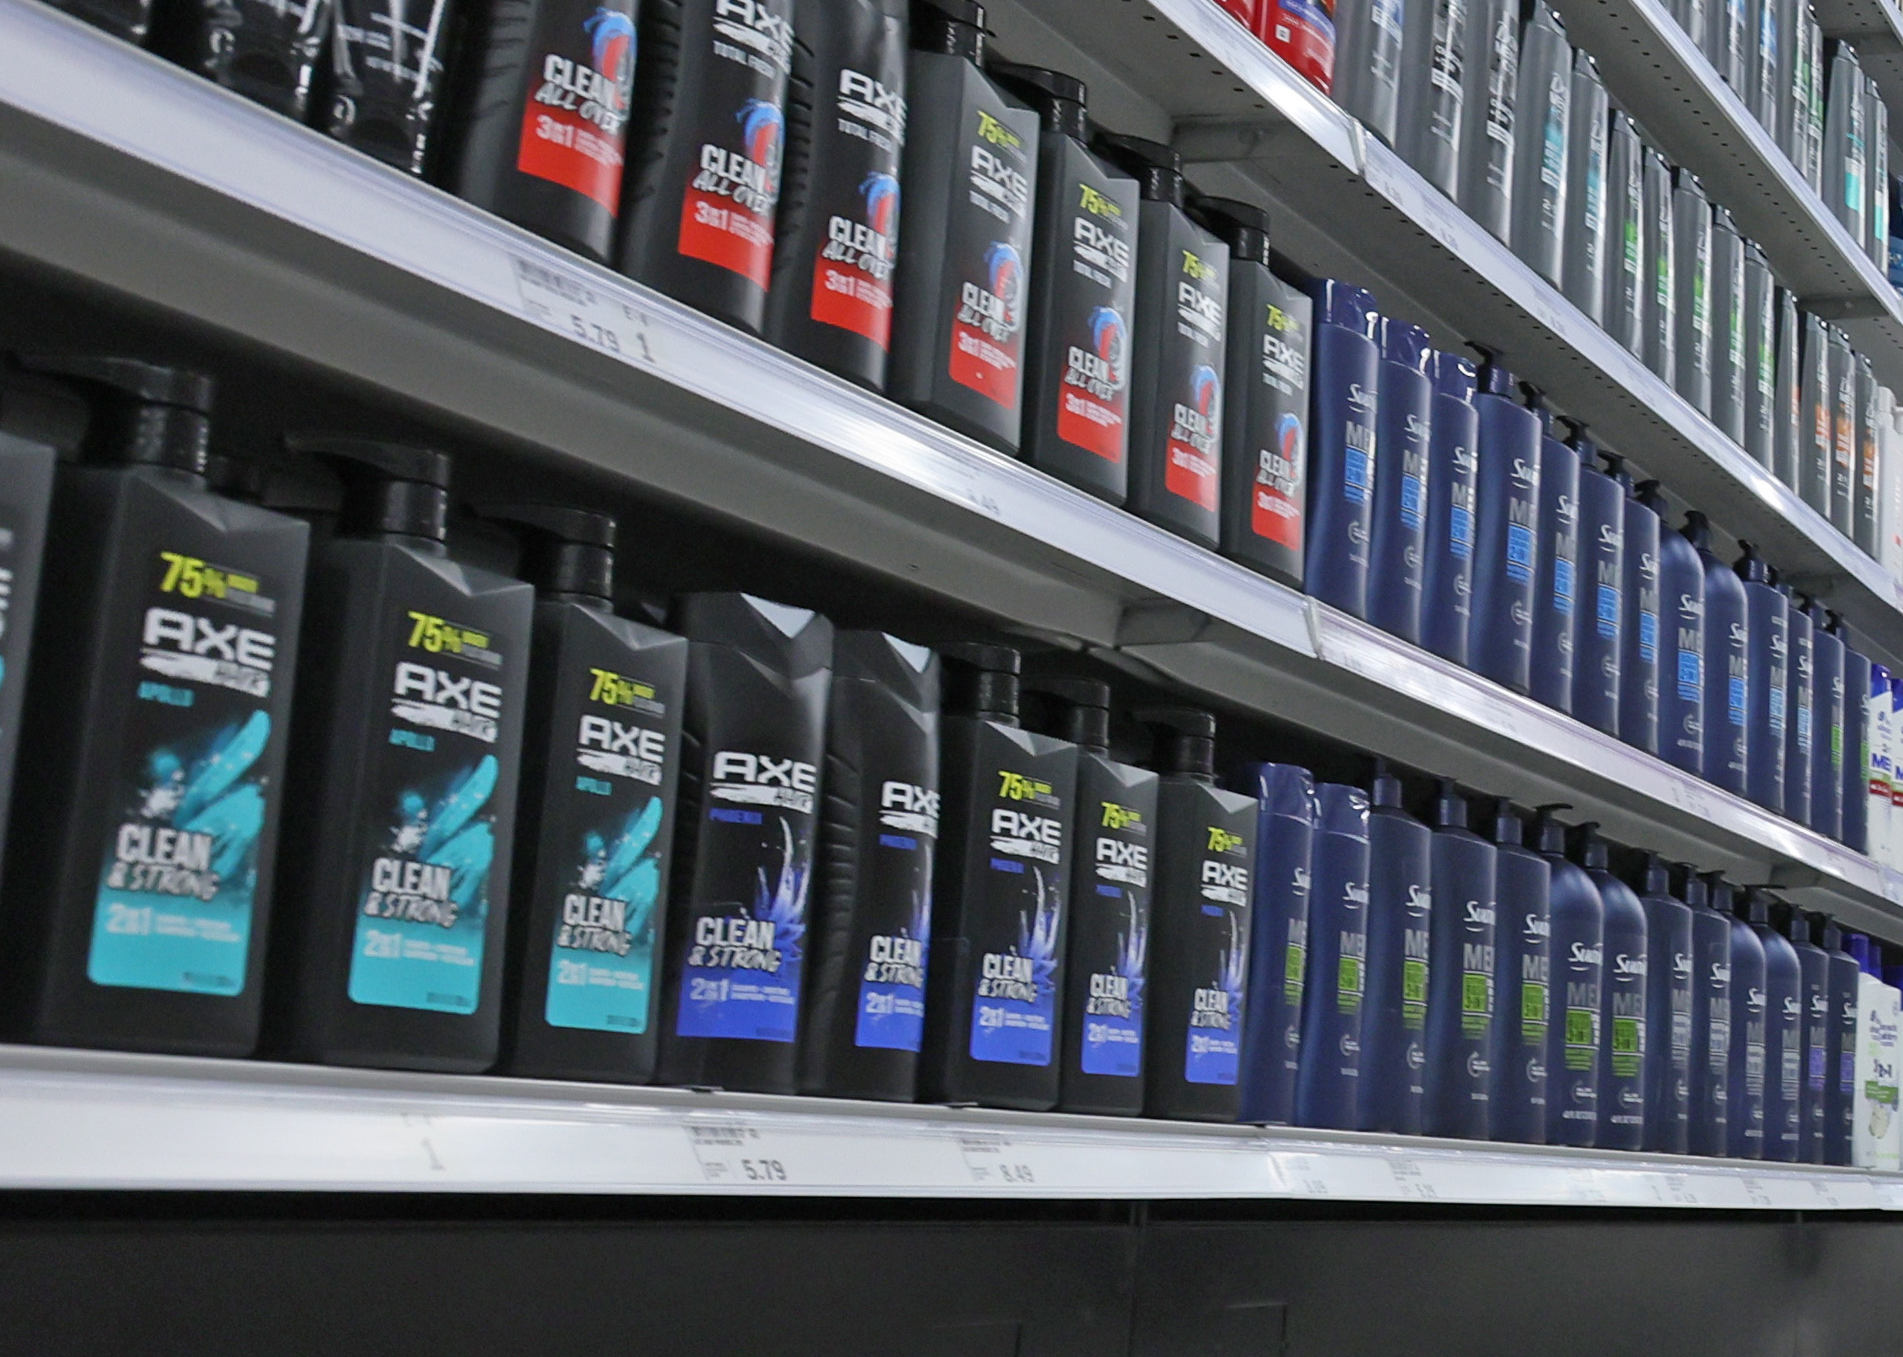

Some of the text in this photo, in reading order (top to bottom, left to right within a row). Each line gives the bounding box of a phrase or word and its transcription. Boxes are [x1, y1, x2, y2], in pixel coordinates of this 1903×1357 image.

[544, 54, 618, 98] CLEAN
[840, 69, 909, 116] AXE
[701, 144, 767, 186] CLEAN
[972, 145, 1028, 201] AXE
[1074, 217, 1129, 270] AXE
[1178, 282, 1222, 325] AXE
[1263, 335, 1304, 376] AXE
[143, 607, 274, 671] AXE
[395, 663, 502, 718] AXE
[578, 716, 665, 762] AXE
[713, 752, 817, 793] AXE
[992, 809, 1062, 844] AXE
[116, 824, 212, 872] CLEAN
[1097, 839, 1147, 870] AXE
[371, 858, 450, 898] CLEAN
[1202, 861, 1247, 891] AXE
[563, 894, 626, 932] CLEAN
[696, 917, 775, 951] CLEAN
[871, 936, 923, 965] CLEAN
[982, 953, 1032, 982] CLEAN
[1090, 974, 1128, 999] CLEAN
[1194, 988, 1228, 1014] CLEAN
[743, 1161, 787, 1182] 5.79
